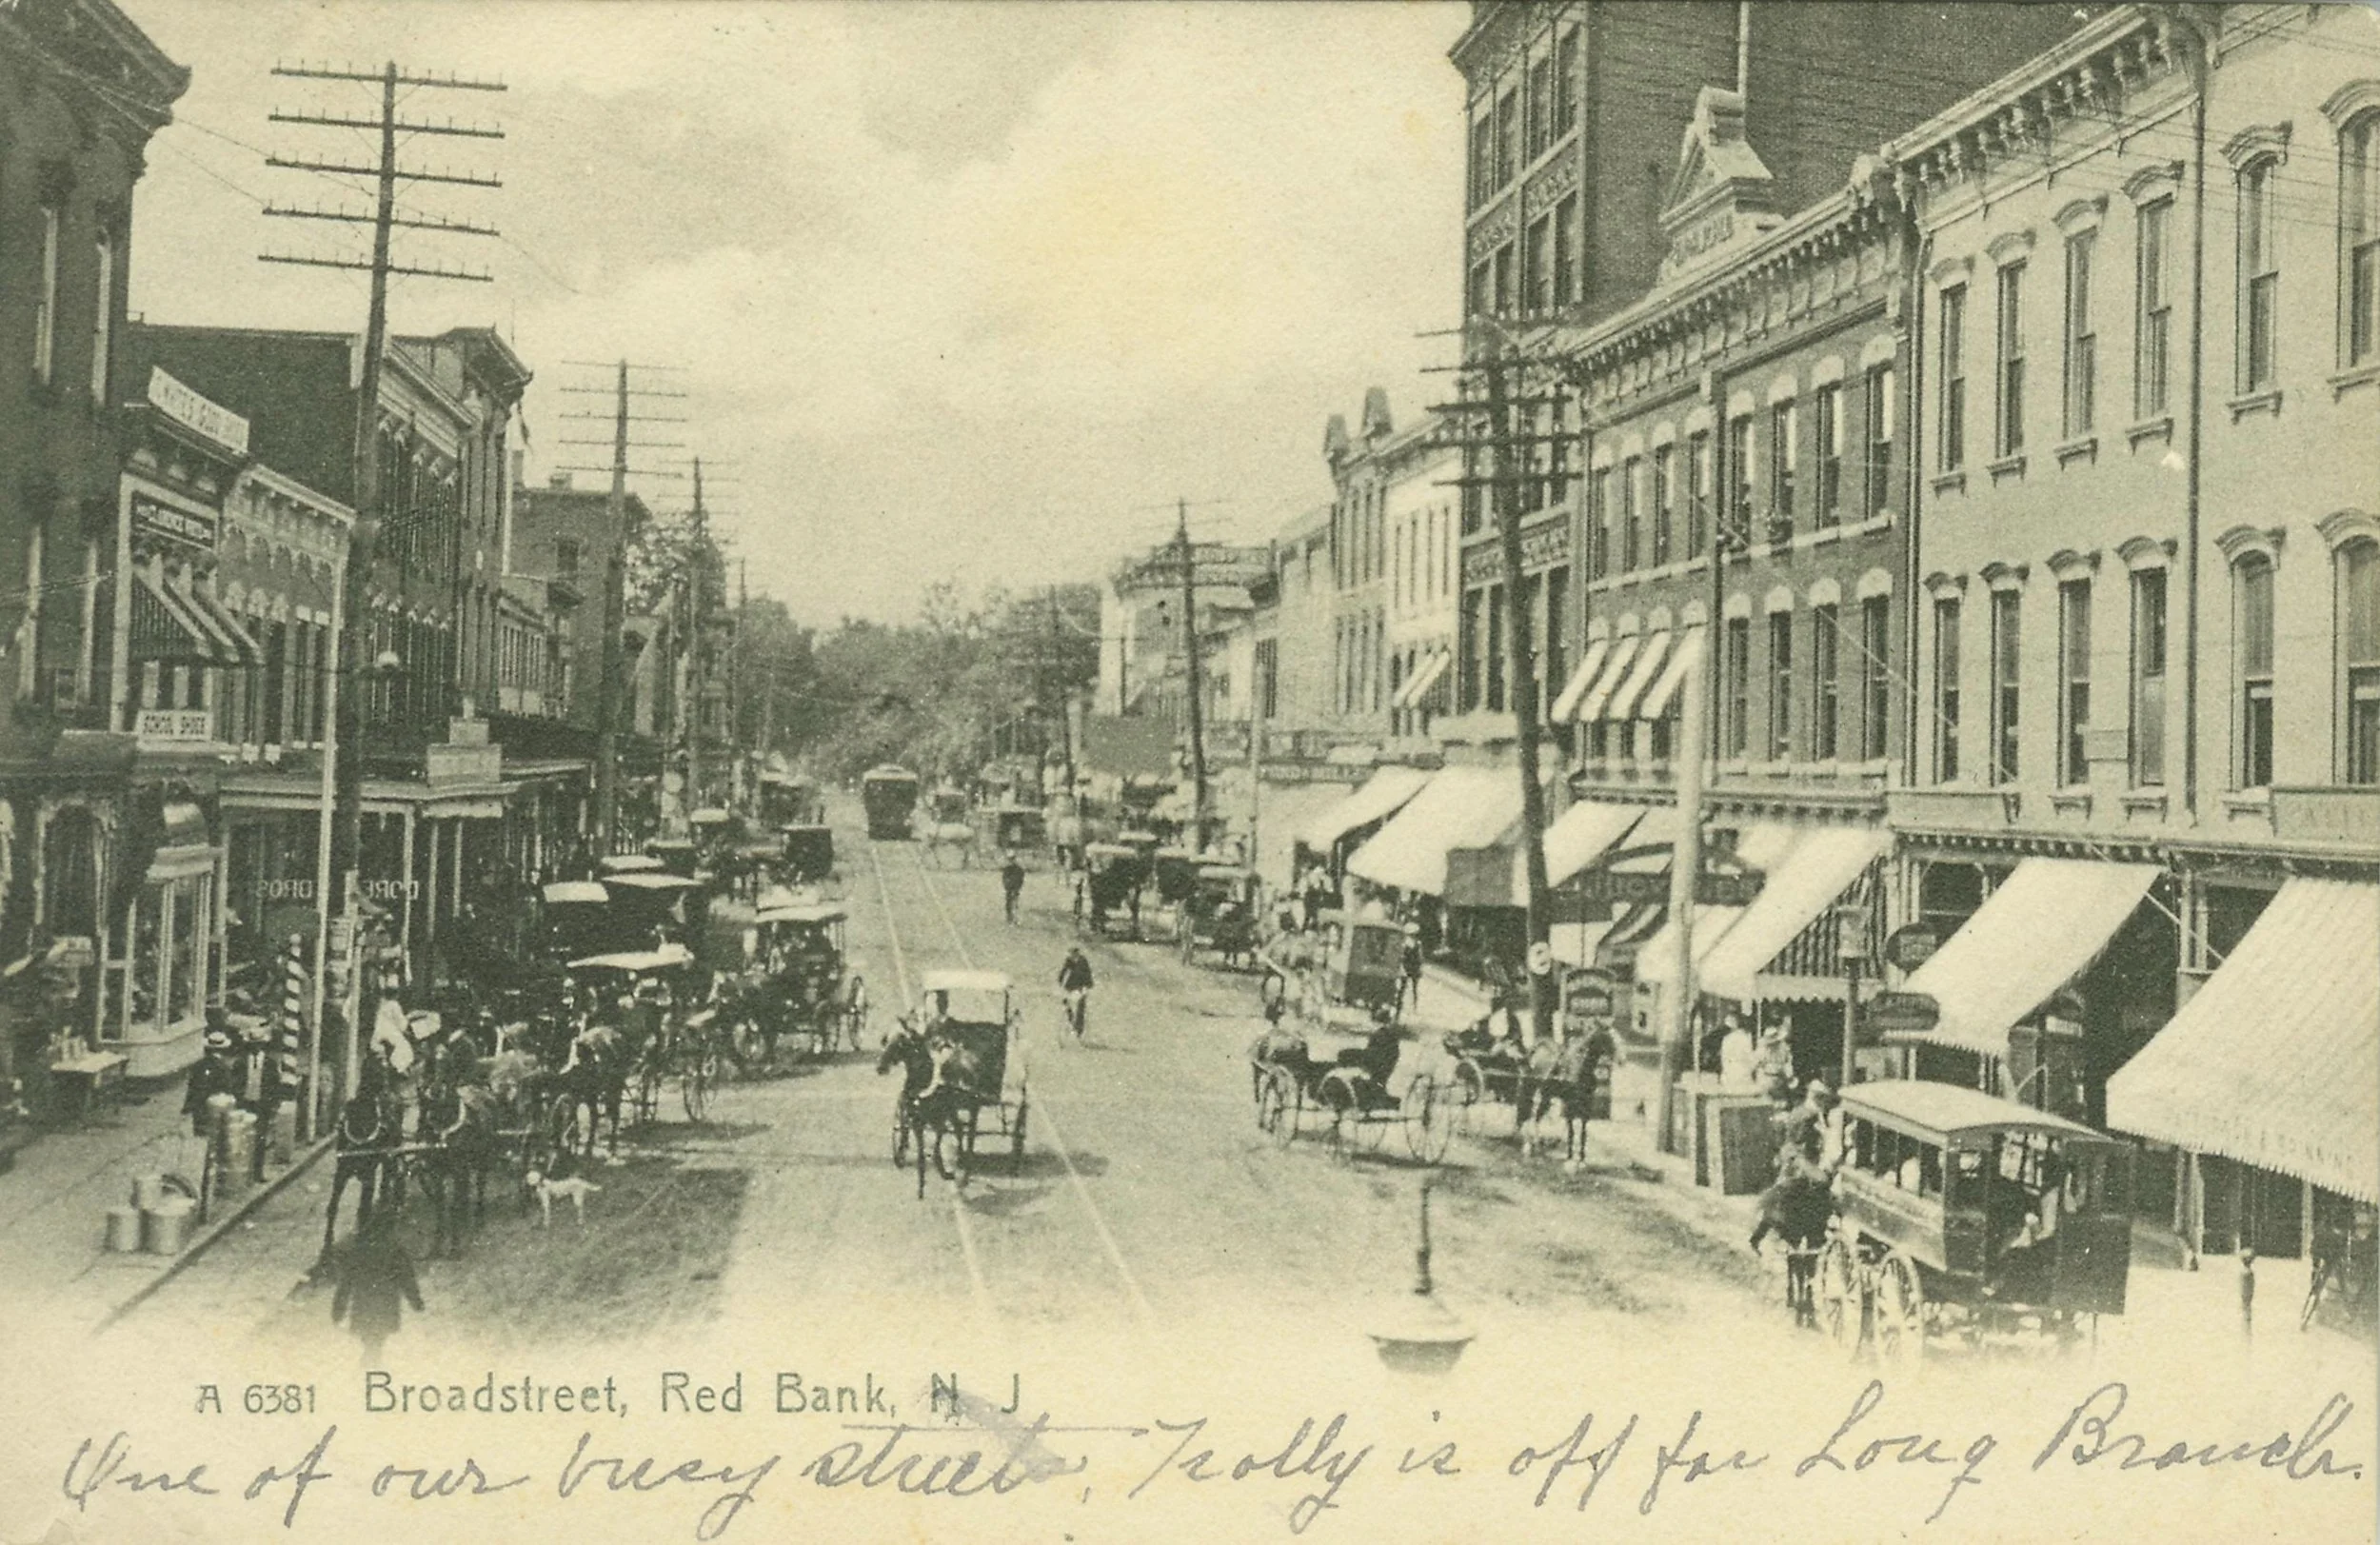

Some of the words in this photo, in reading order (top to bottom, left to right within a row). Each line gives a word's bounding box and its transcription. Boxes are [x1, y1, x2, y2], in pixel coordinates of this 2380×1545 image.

[62, 1430, 220, 1512] One
[244, 1424, 338, 1528] of
[370, 1457, 531, 1500] our
[557, 1432, 781, 1542] busy
[1395, 1409, 1462, 1475] is
[1508, 1412, 1639, 1512] off
[1639, 1410, 1771, 1515] for
[1795, 1378, 2000, 1525] Long
